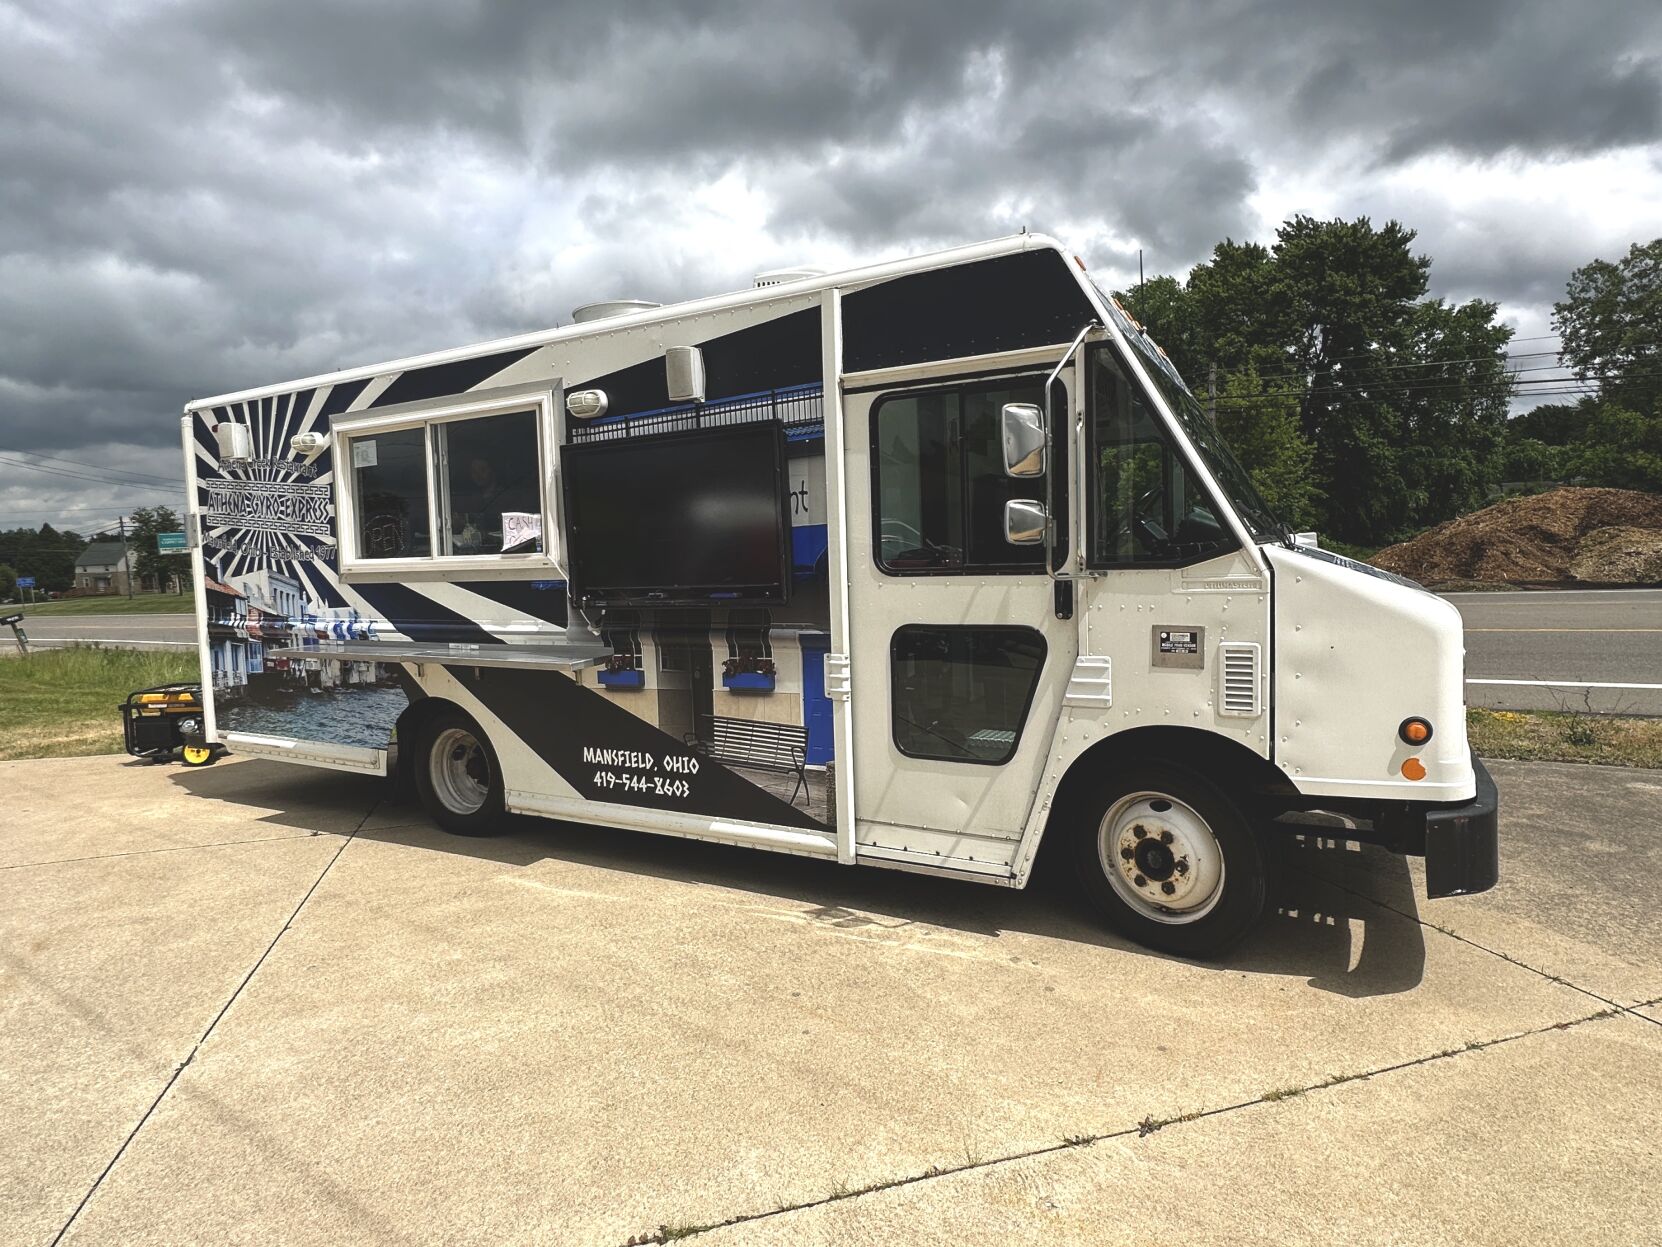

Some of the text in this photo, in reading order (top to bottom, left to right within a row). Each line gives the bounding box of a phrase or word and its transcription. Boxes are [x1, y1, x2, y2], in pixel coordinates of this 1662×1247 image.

[272, 456, 318, 478] Restaurant
[208, 491, 330, 523] ATHENA GYRO EXPRESS
[240, 542, 262, 558] Ohio
[269, 543, 315, 562] Established
[316, 544, 337, 560] 1977
[583, 746, 700, 775] MANSFIELD, OHIO
[593, 770, 690, 798] 419-544-8603
